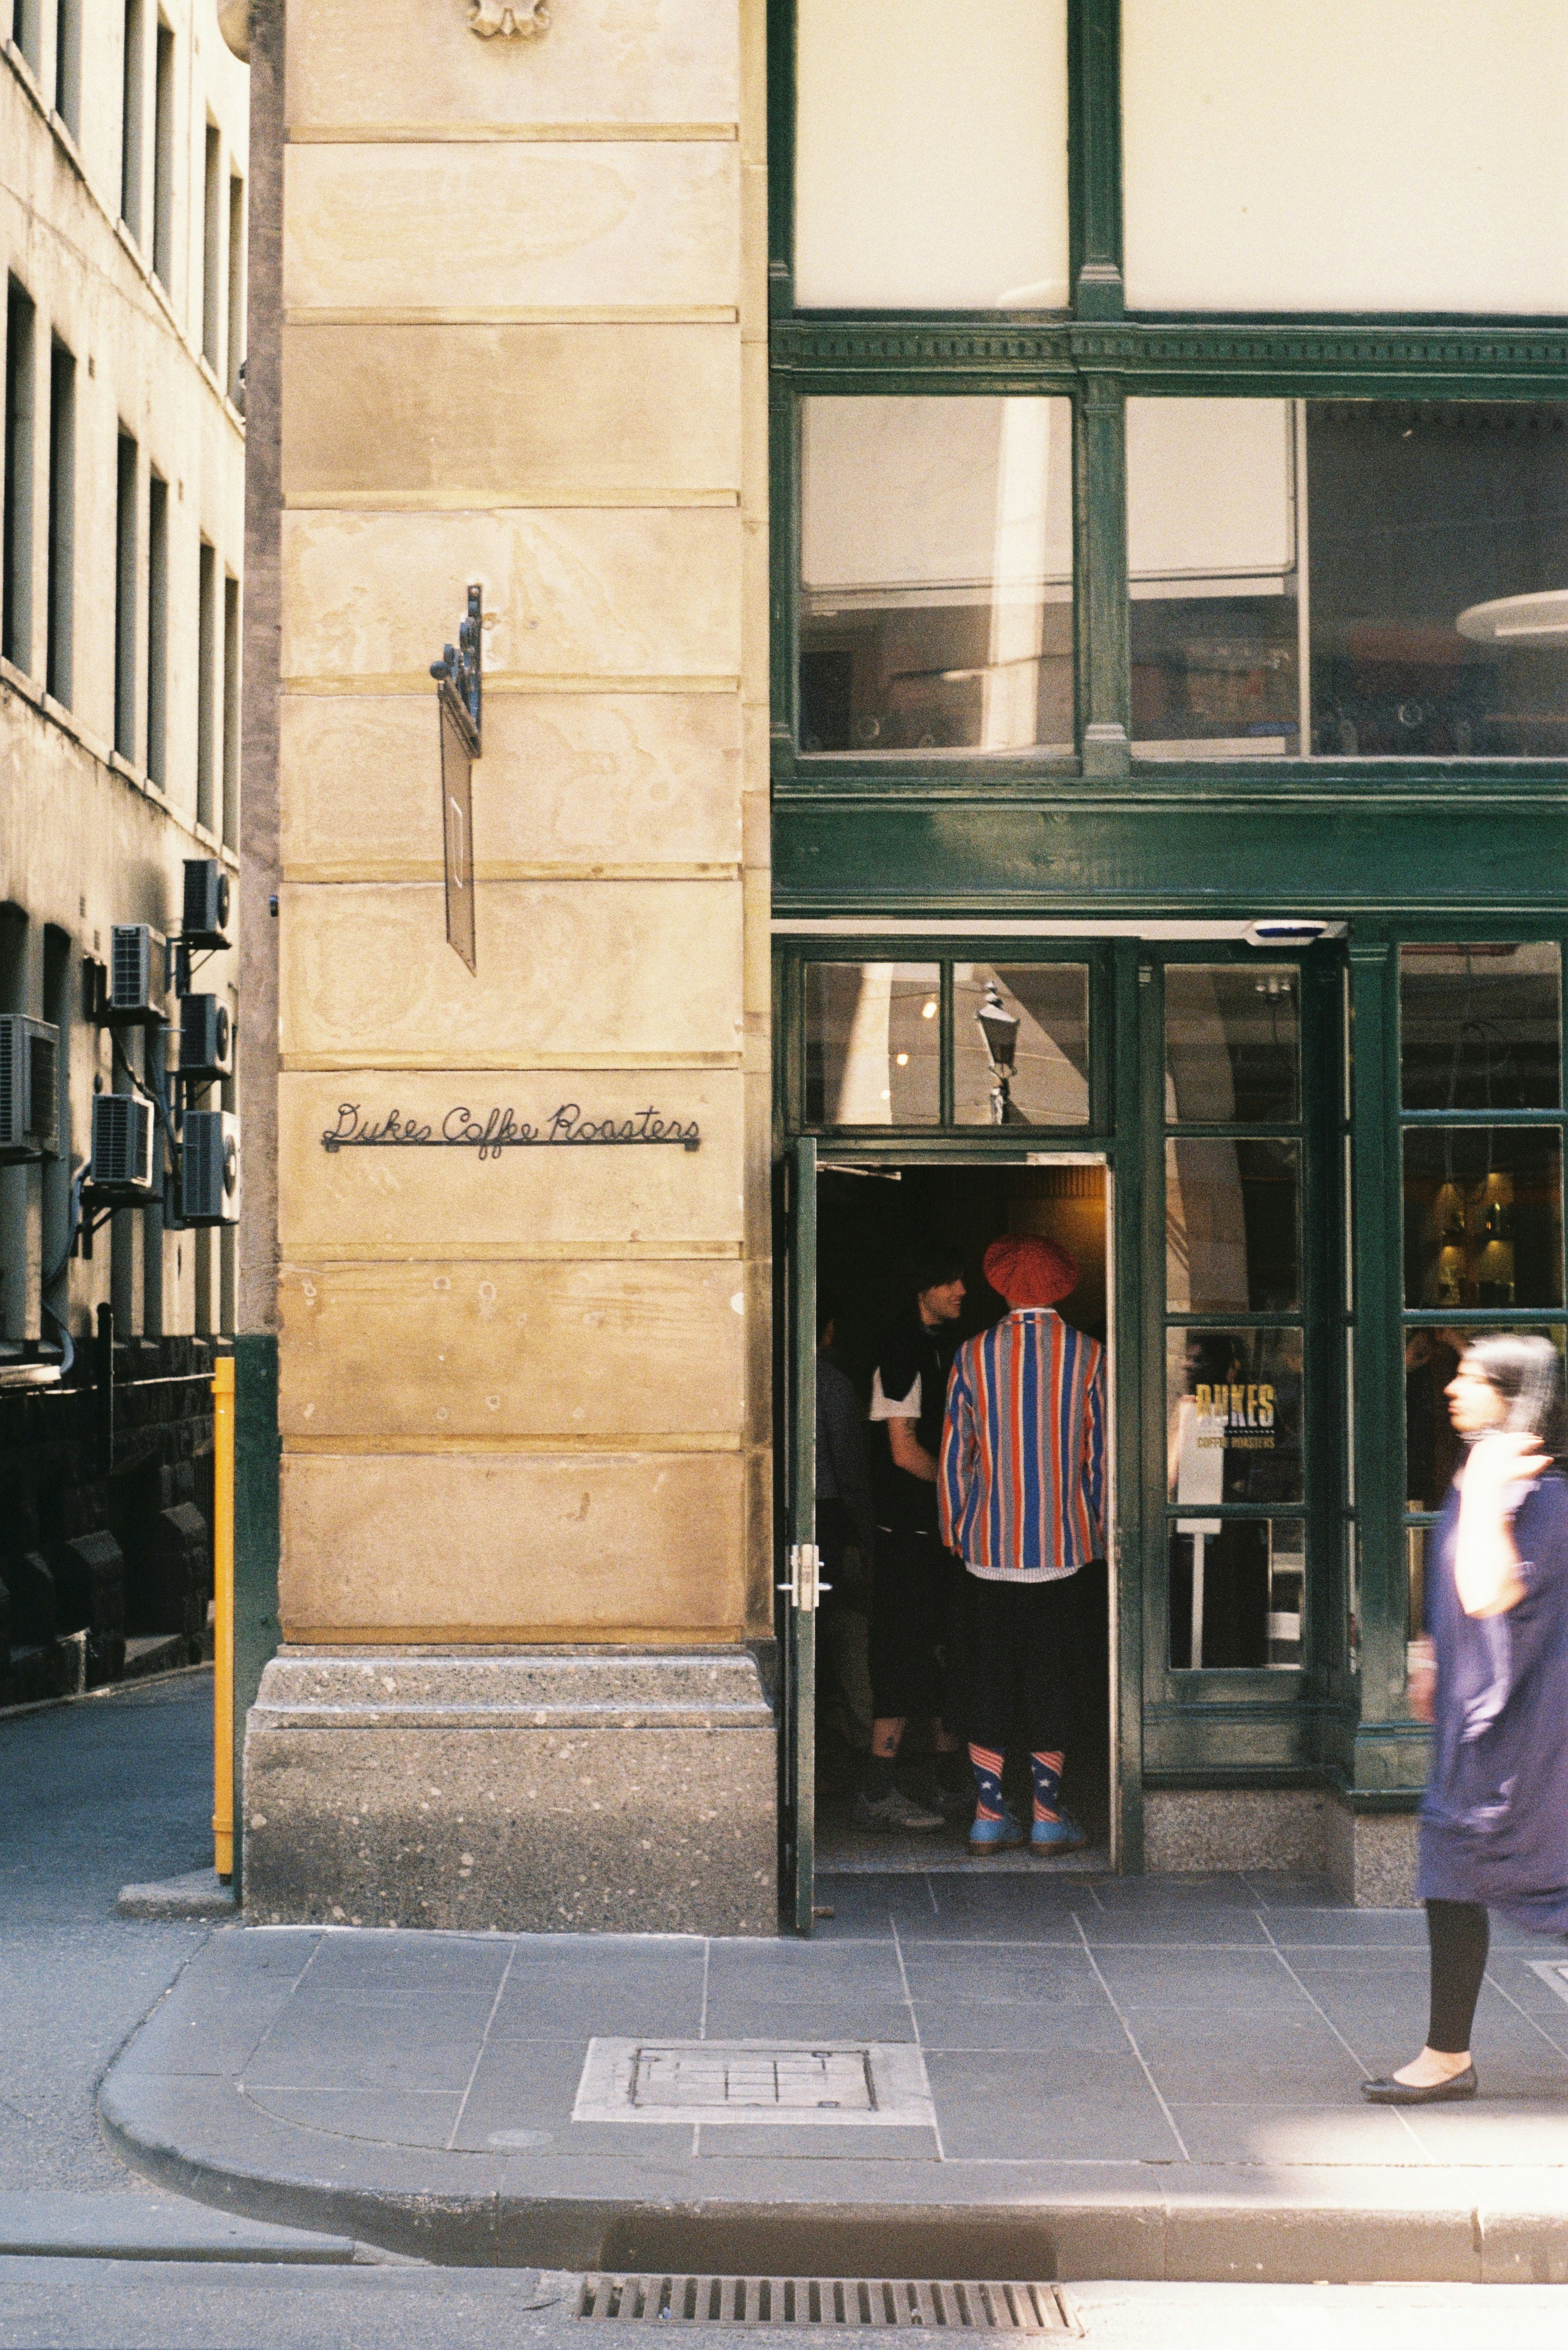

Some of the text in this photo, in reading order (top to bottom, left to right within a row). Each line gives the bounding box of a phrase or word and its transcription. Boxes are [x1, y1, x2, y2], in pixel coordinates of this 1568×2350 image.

[325, 1103, 700, 1161] Dukes Coffee Roasters
[1196, 1384, 1274, 1427] DUKES
